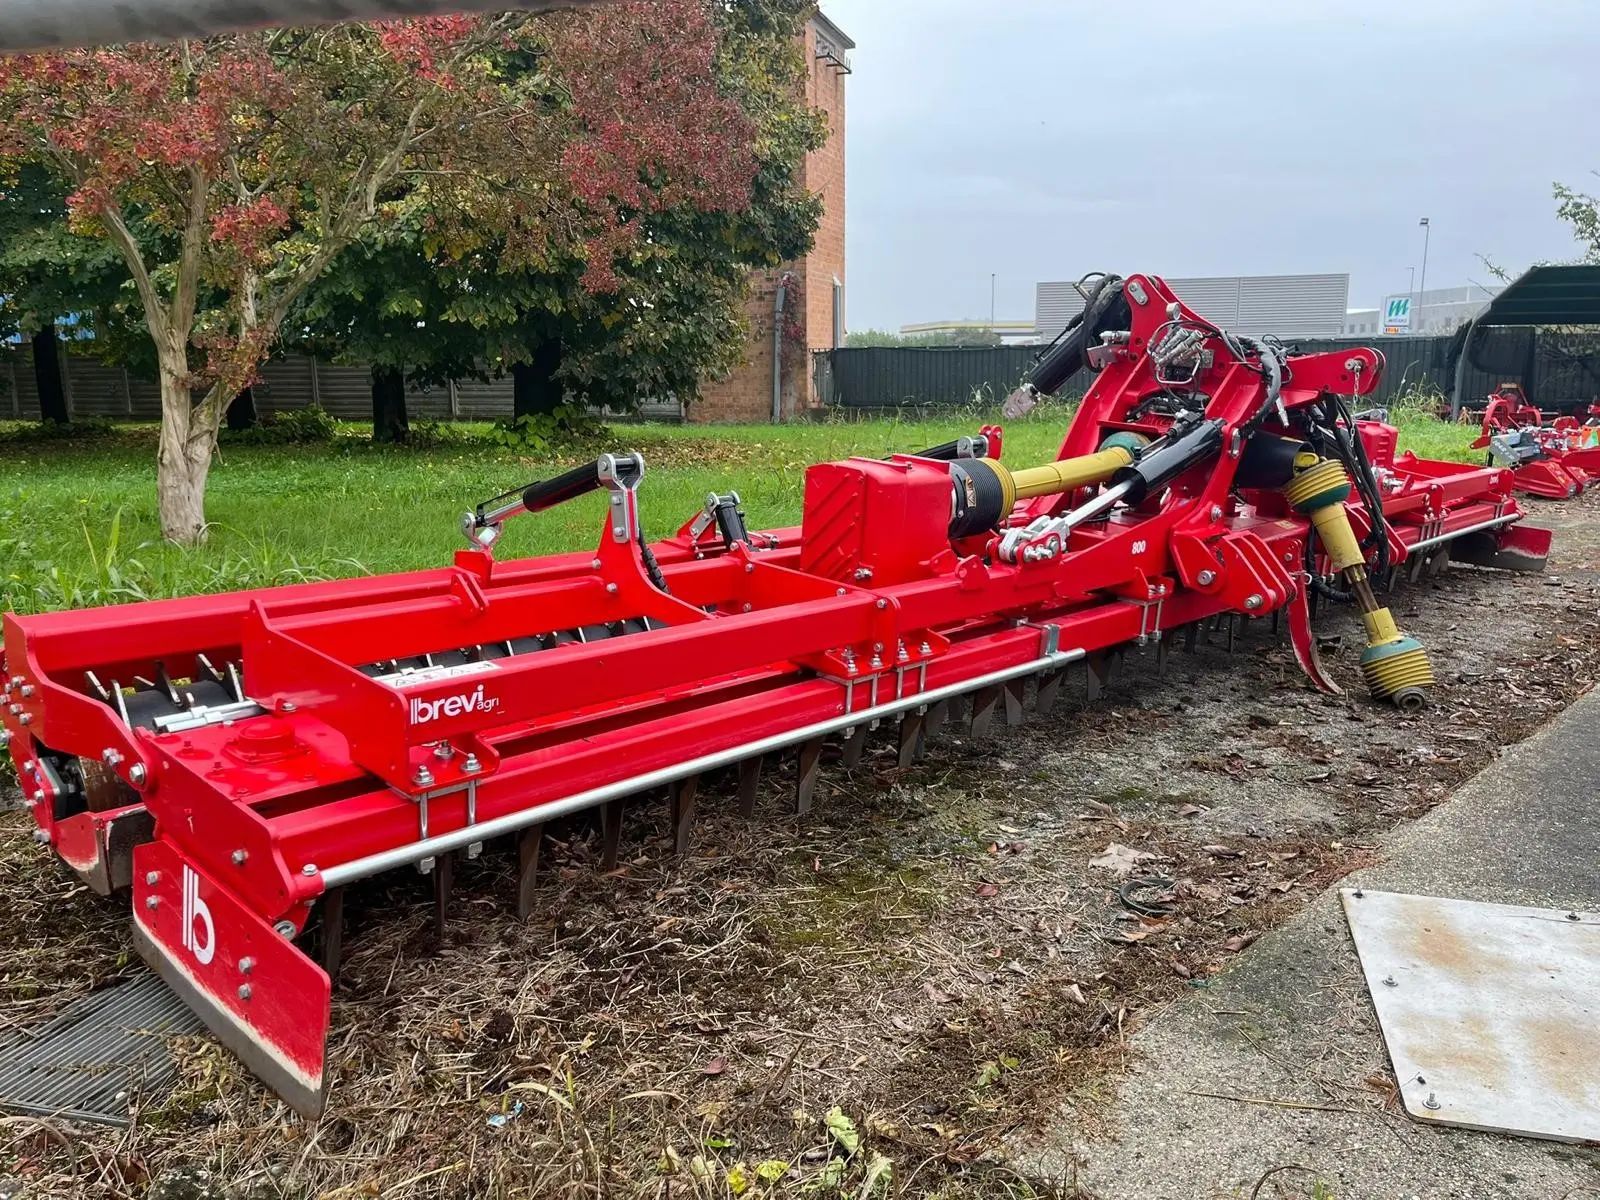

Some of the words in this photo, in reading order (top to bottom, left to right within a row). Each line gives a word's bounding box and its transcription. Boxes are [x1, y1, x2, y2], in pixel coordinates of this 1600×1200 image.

[1132, 540, 1146, 555] 800
[410, 684, 484, 725] brevi
[476, 697, 500, 713] agri
